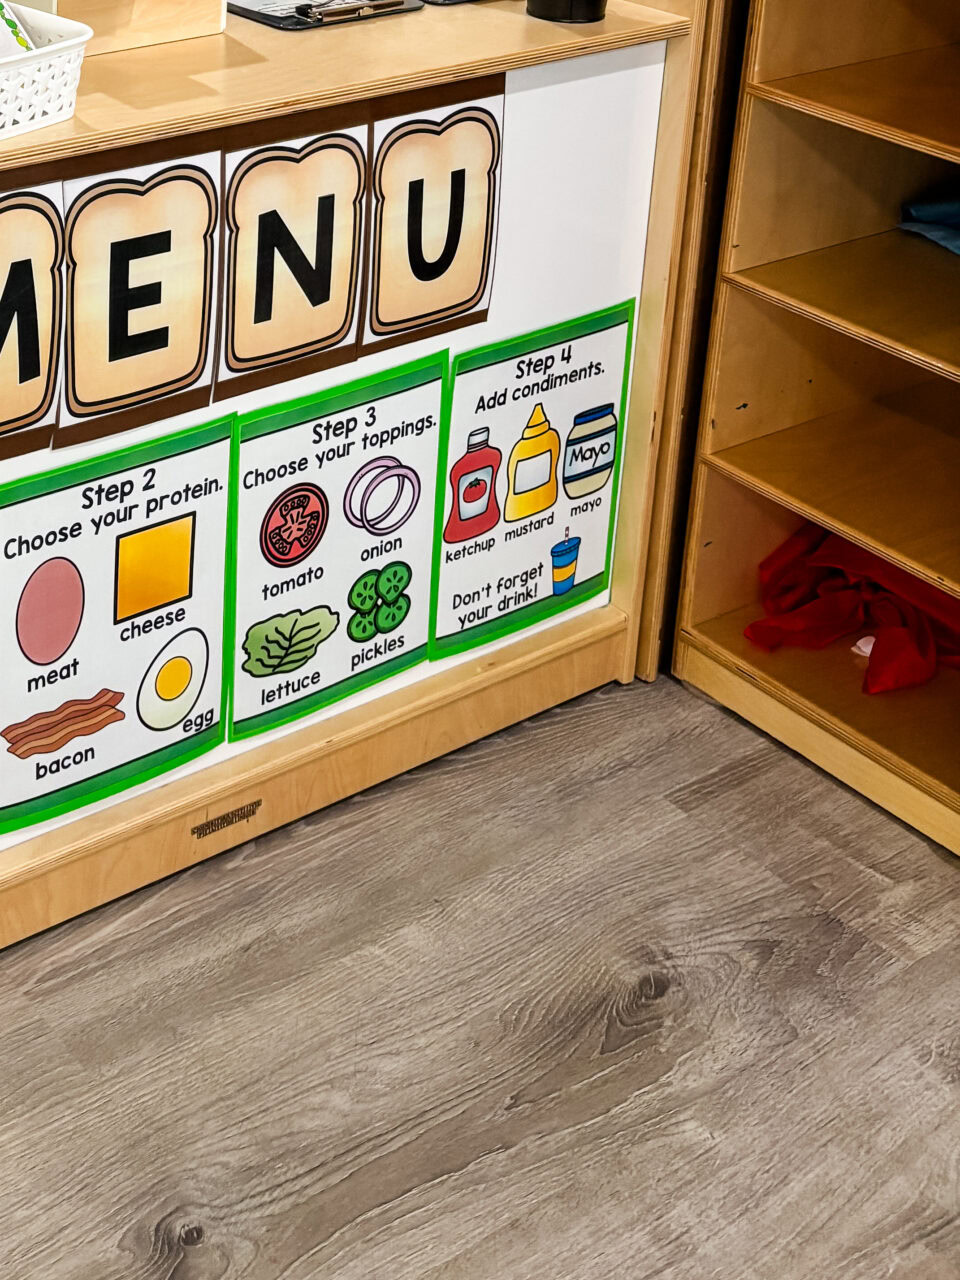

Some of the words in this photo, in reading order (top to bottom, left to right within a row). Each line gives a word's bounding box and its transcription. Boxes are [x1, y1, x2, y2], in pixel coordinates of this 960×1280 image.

[515, 354, 555, 380] Step
[561, 345, 573, 364] 4
[474, 389, 507, 414] Add
[512, 360, 605, 402] condiments.
[312, 415, 358, 446] Step
[364, 406, 377, 427] 3
[242, 457, 309, 490] Choose
[315, 440, 356, 470] your
[361, 413, 437, 452] toppings.
[568, 440, 611, 468] Mayo
[81, 479, 134, 510] Step
[142, 468, 157, 492] 2
[570, 495, 602, 518] mayo
[3, 520, 83, 560] Choose
[90, 502, 139, 535] your
[145, 475, 224, 519] protein.
[504, 511, 555, 543] mustard
[359, 536, 403, 563] onion
[445, 535, 496, 564] ketchup
[261, 565, 325, 602] tomato
[452, 582, 492, 610] Don't
[496, 561, 544, 598] forget
[457, 603, 493, 630] your
[496, 581, 539, 612] drink!
[119, 607, 186, 642] cheese
[350, 635, 405, 671] pickles
[26, 658, 80, 692] meat
[260, 671, 322, 706] lettuce
[182, 707, 215, 734] egg
[35, 746, 96, 780] bacon
